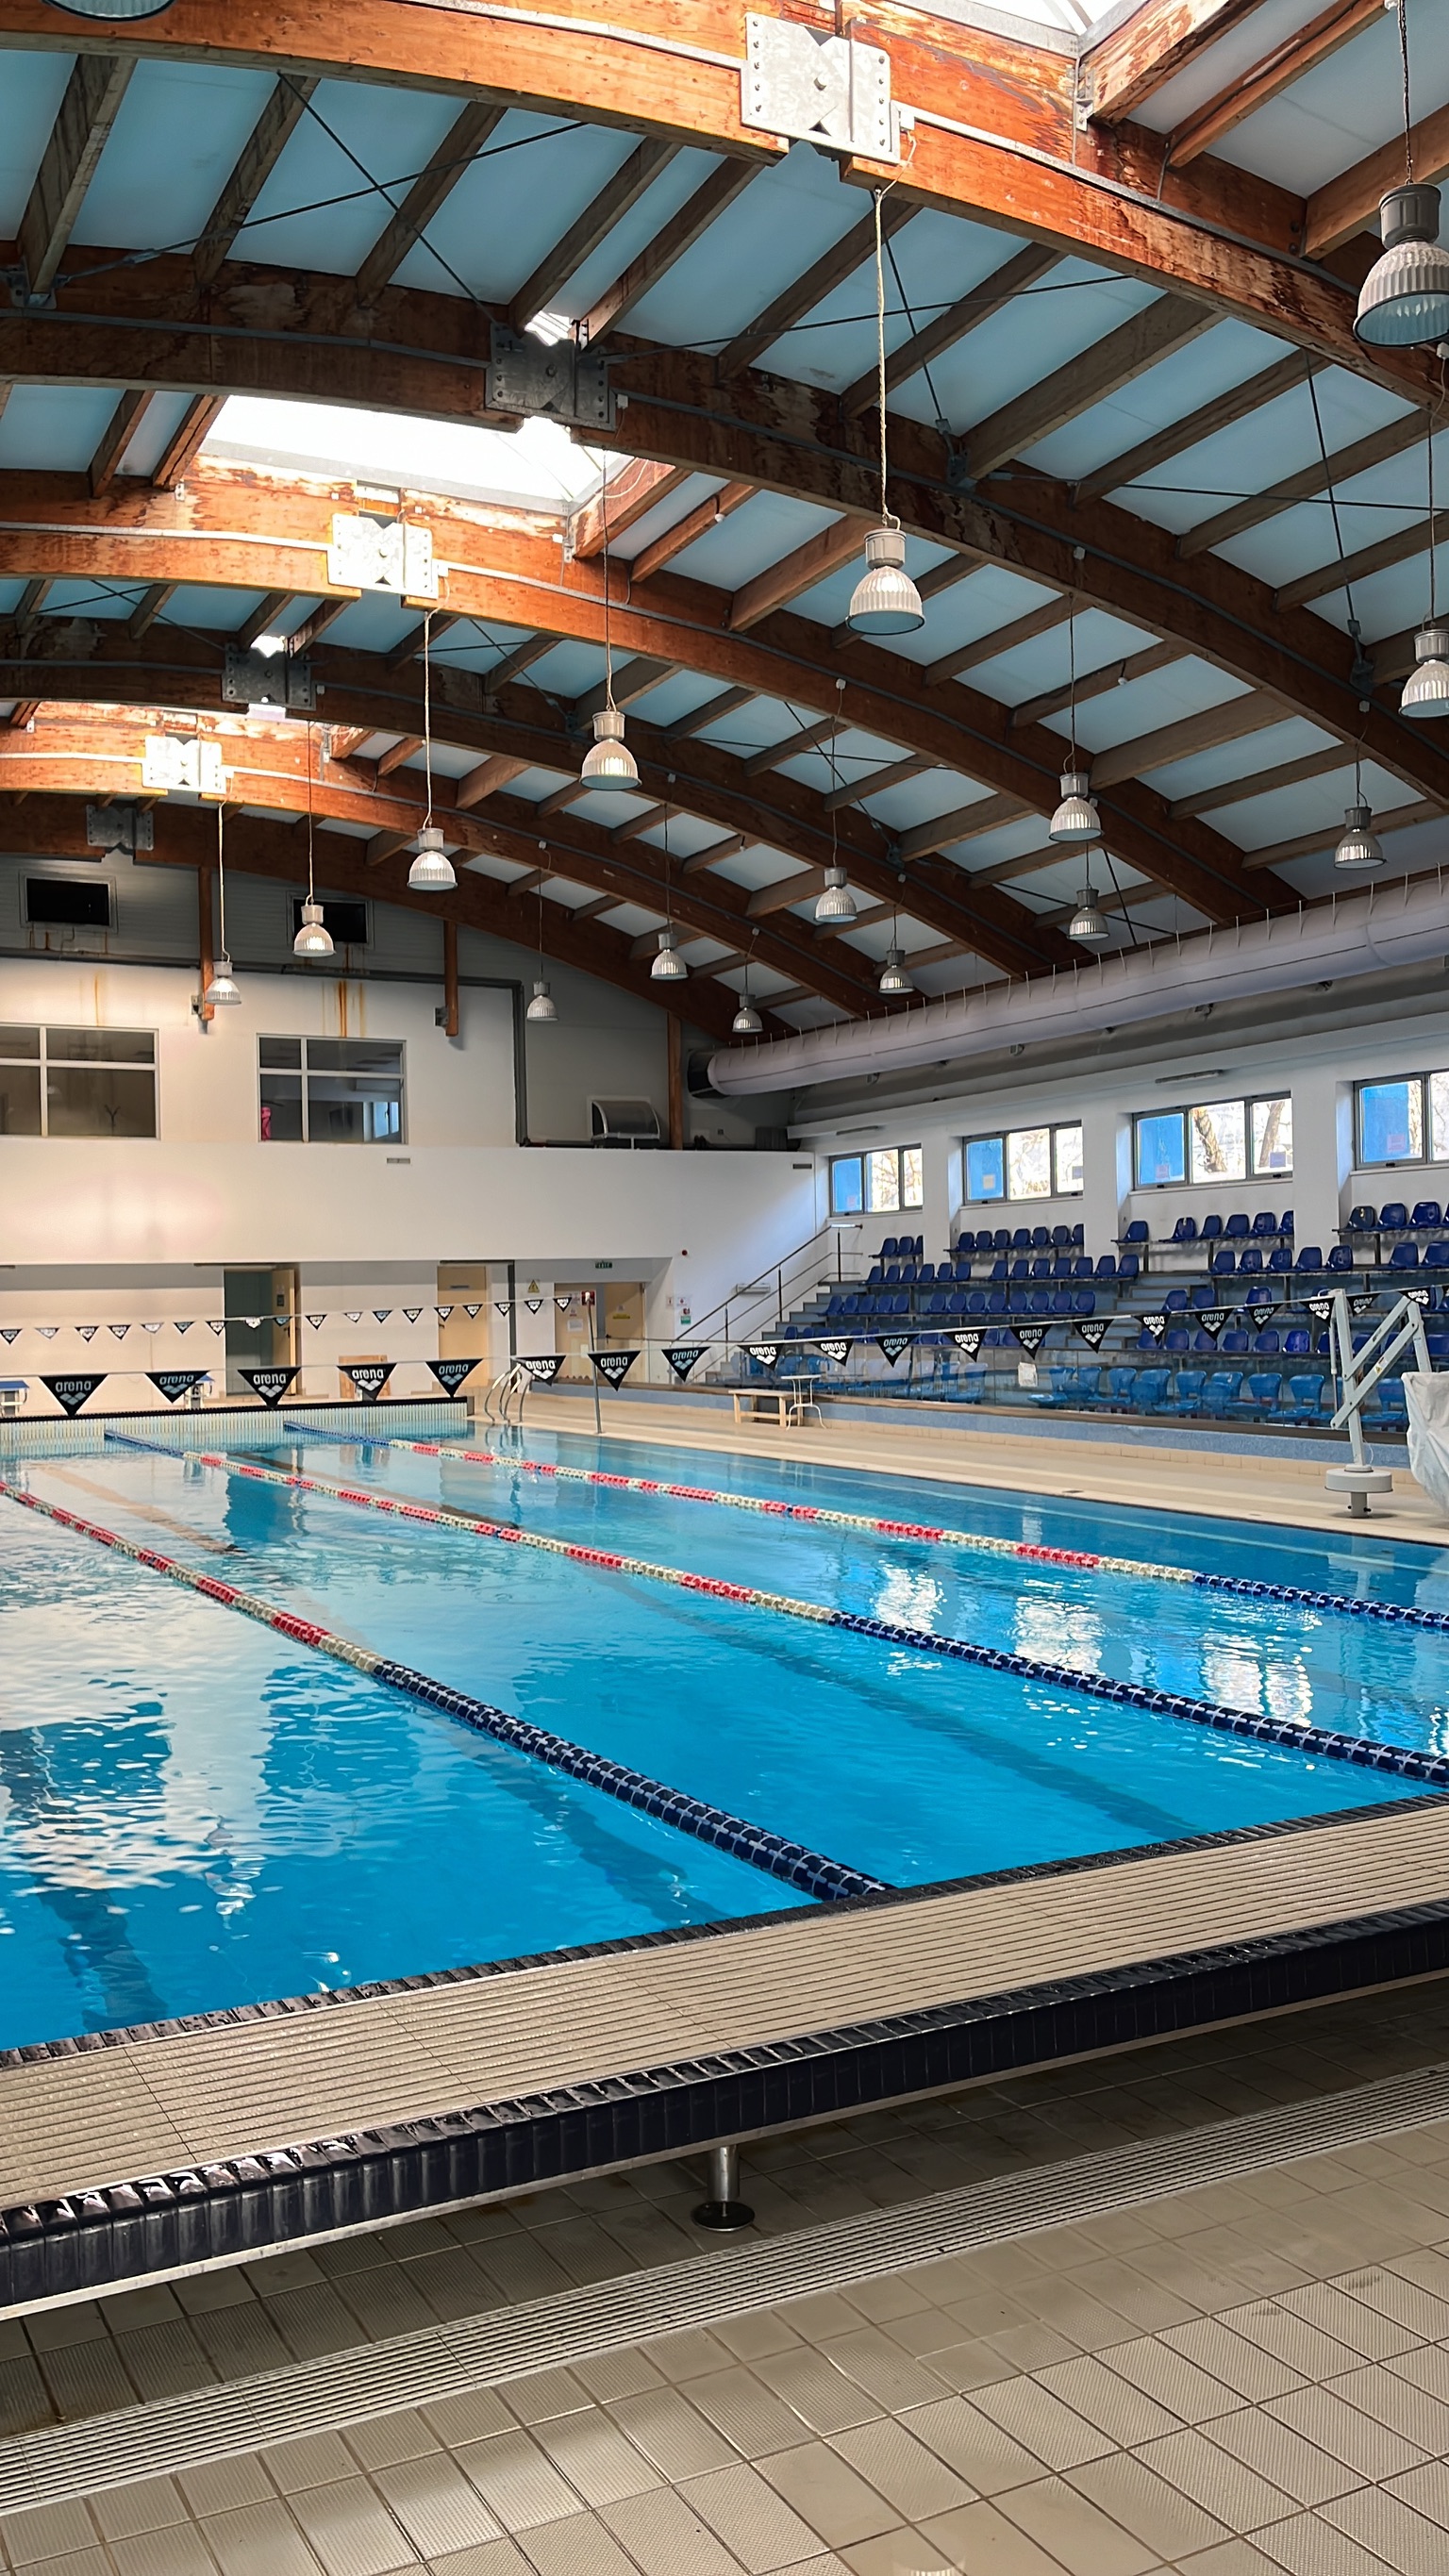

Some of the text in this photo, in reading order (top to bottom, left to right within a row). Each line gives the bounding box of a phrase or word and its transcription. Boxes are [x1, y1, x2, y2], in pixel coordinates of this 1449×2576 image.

[1020, 1328, 1042, 1338] arena
[1081, 1322, 1105, 1333] arena
[883, 1337, 908, 1347] arena
[955, 1333, 979, 1343] arena
[749, 1345, 776, 1356] arena
[820, 1341, 847, 1352] arena
[672, 1349, 699, 1360] arena
[525, 1359, 556, 1371] arena
[600, 1356, 628, 1368] arena
[351, 1368, 384, 1380] arena
[439, 1363, 469, 1374] arena
[159, 1374, 194, 1386] arena
[253, 1373, 287, 1386] arena
[55, 1381, 92, 1393] arena
